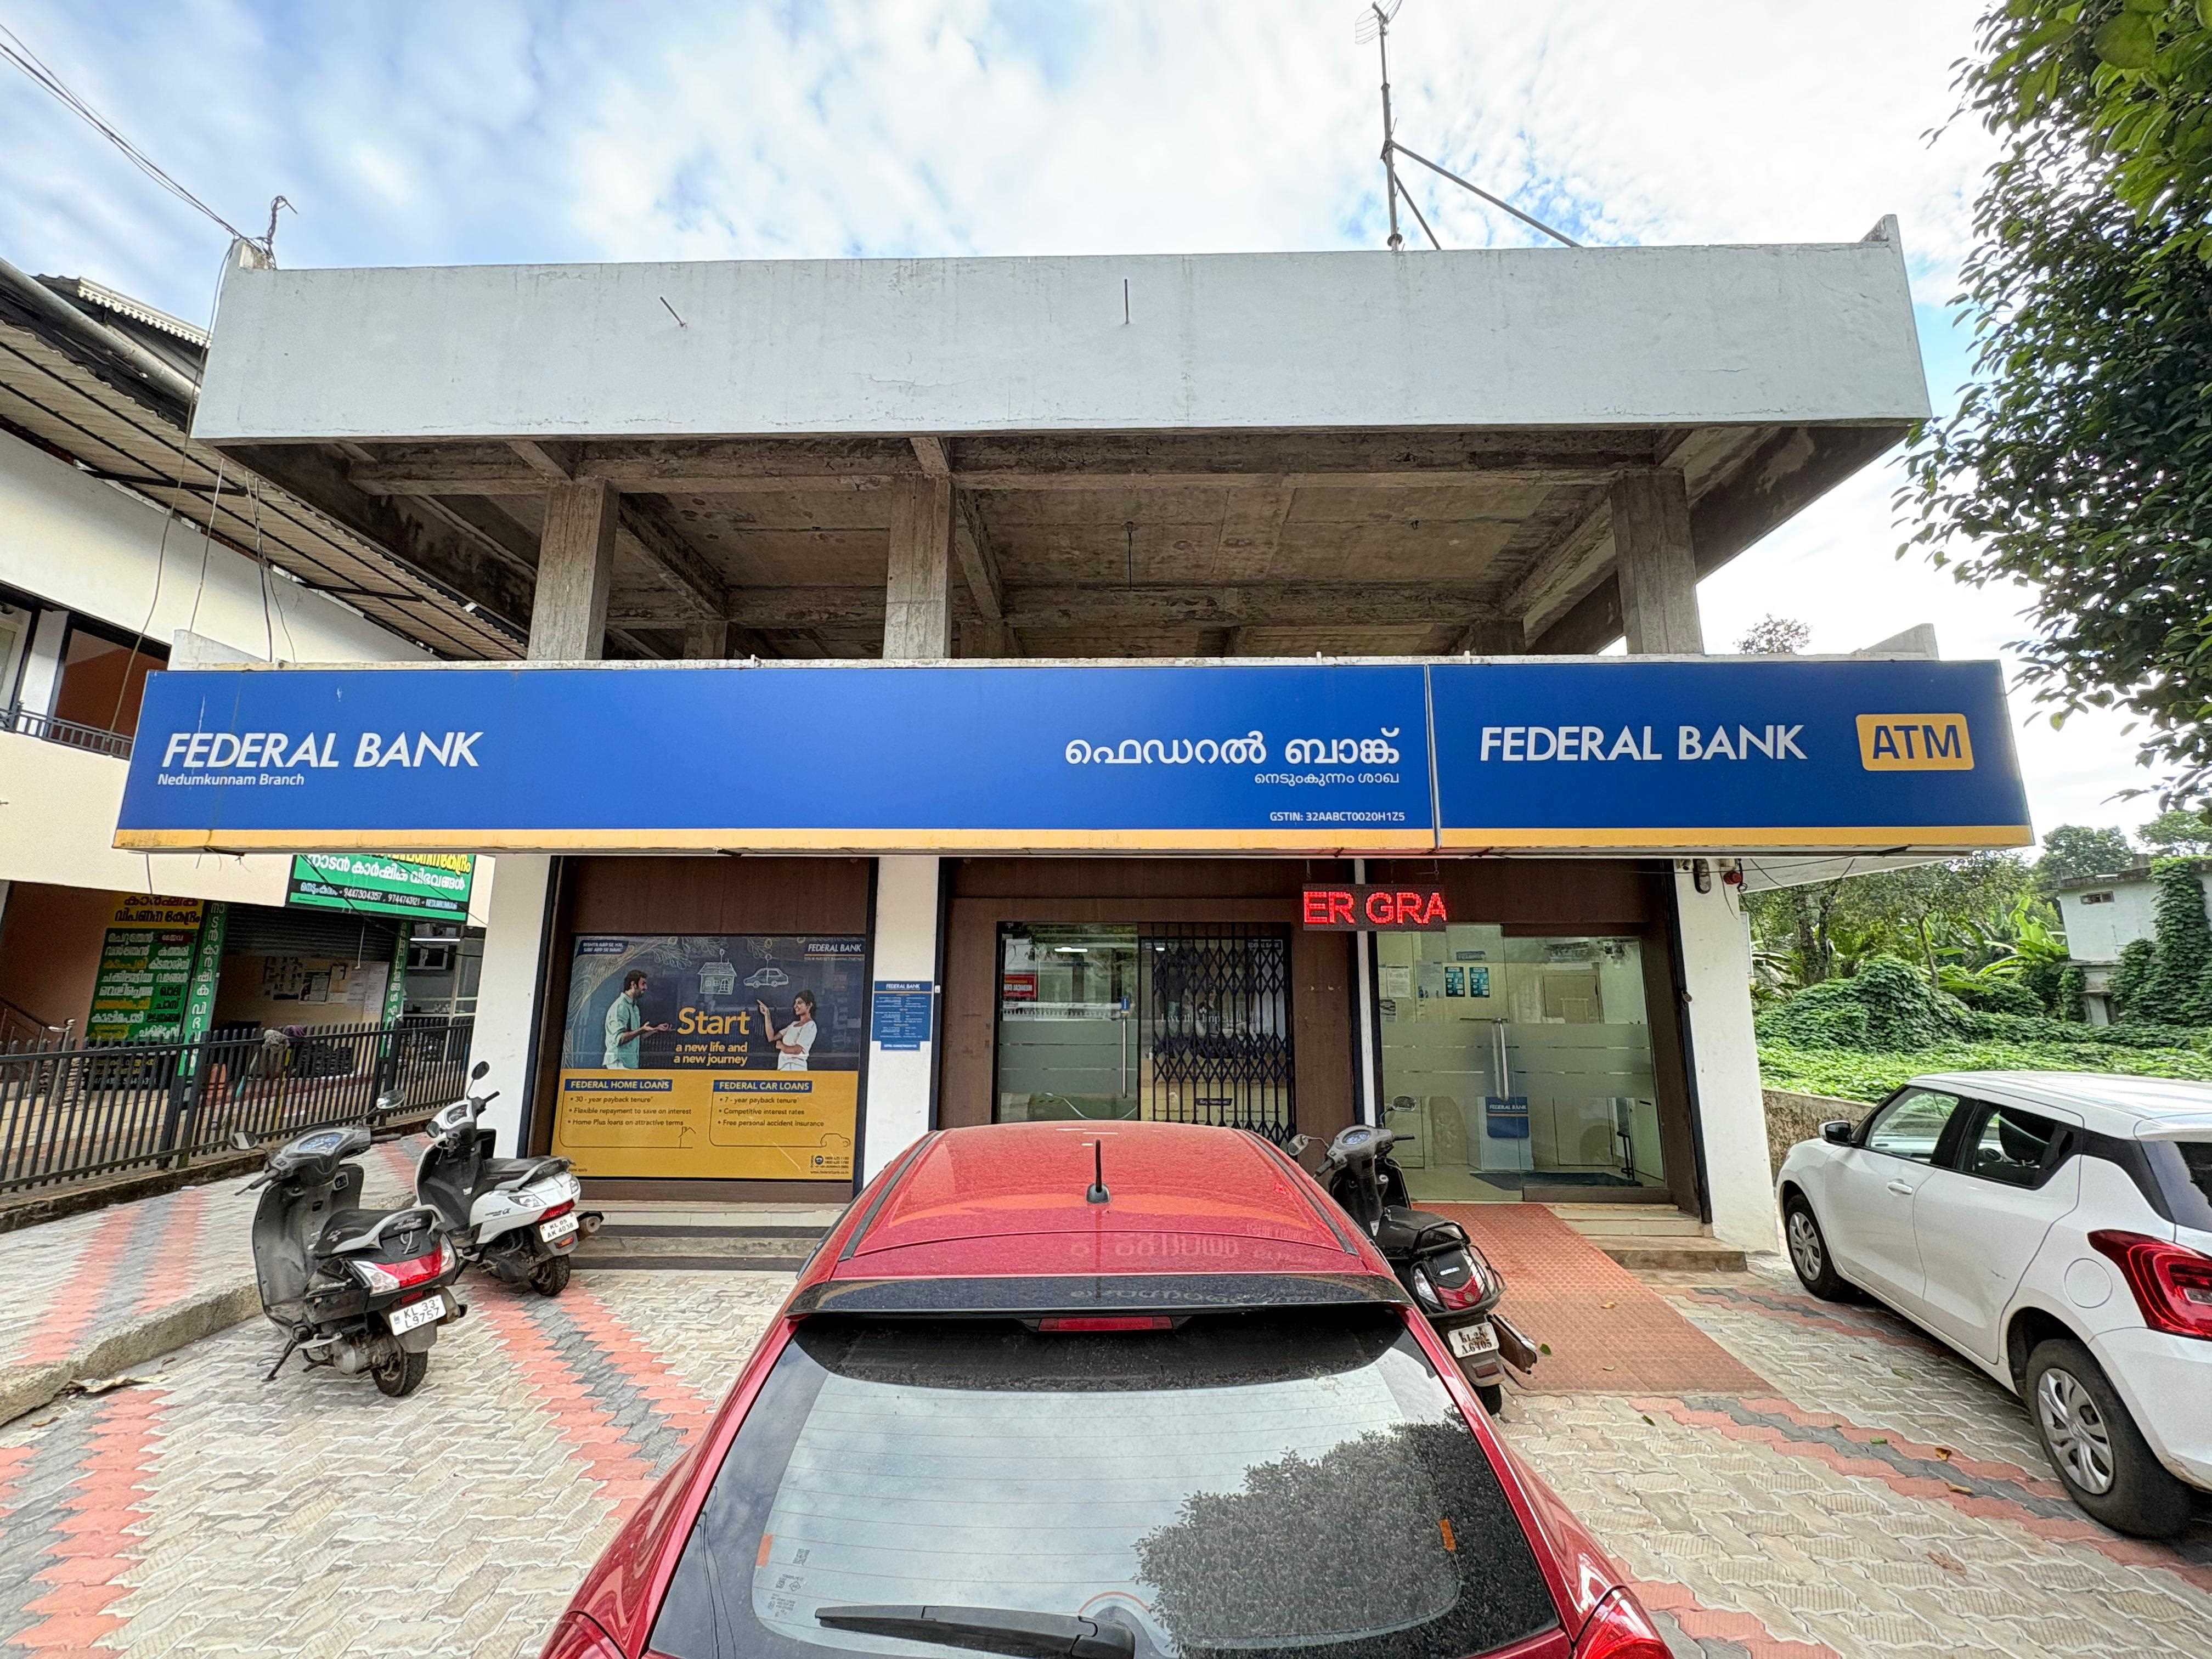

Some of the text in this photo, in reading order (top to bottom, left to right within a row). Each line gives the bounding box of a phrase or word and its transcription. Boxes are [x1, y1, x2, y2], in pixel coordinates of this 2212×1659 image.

[1065, 727, 1400, 765] ഫെഡറൽ ബാങ്ക്
[1480, 724, 1808, 761] FEDERAL BANK
[1872, 724, 1962, 759] ATM
[162, 731, 484, 768] FEDERAL BANK
[157, 773, 304, 785] Nedumkunnam Branch
[1254, 772, 1400, 787] നെടുംകുന്നം ശാഖ
[1269, 812, 1405, 821] GSTIN: 32AABCT0020H1Z5
[1303, 891, 1447, 924] ER GRA
[808, 944, 862, 952] FEDERAL BANK
[677, 1007, 752, 1035] Start
[684, 1044, 708, 1052] new
[709, 1041, 725, 1052] life
[727, 1041, 747, 1052] and
[706, 1053, 747, 1066] journey
[724, 1108, 761, 1116] Competitive
[558, 1222, 574, 1233] 4038
[404, 1299, 436, 1319] KL 33
